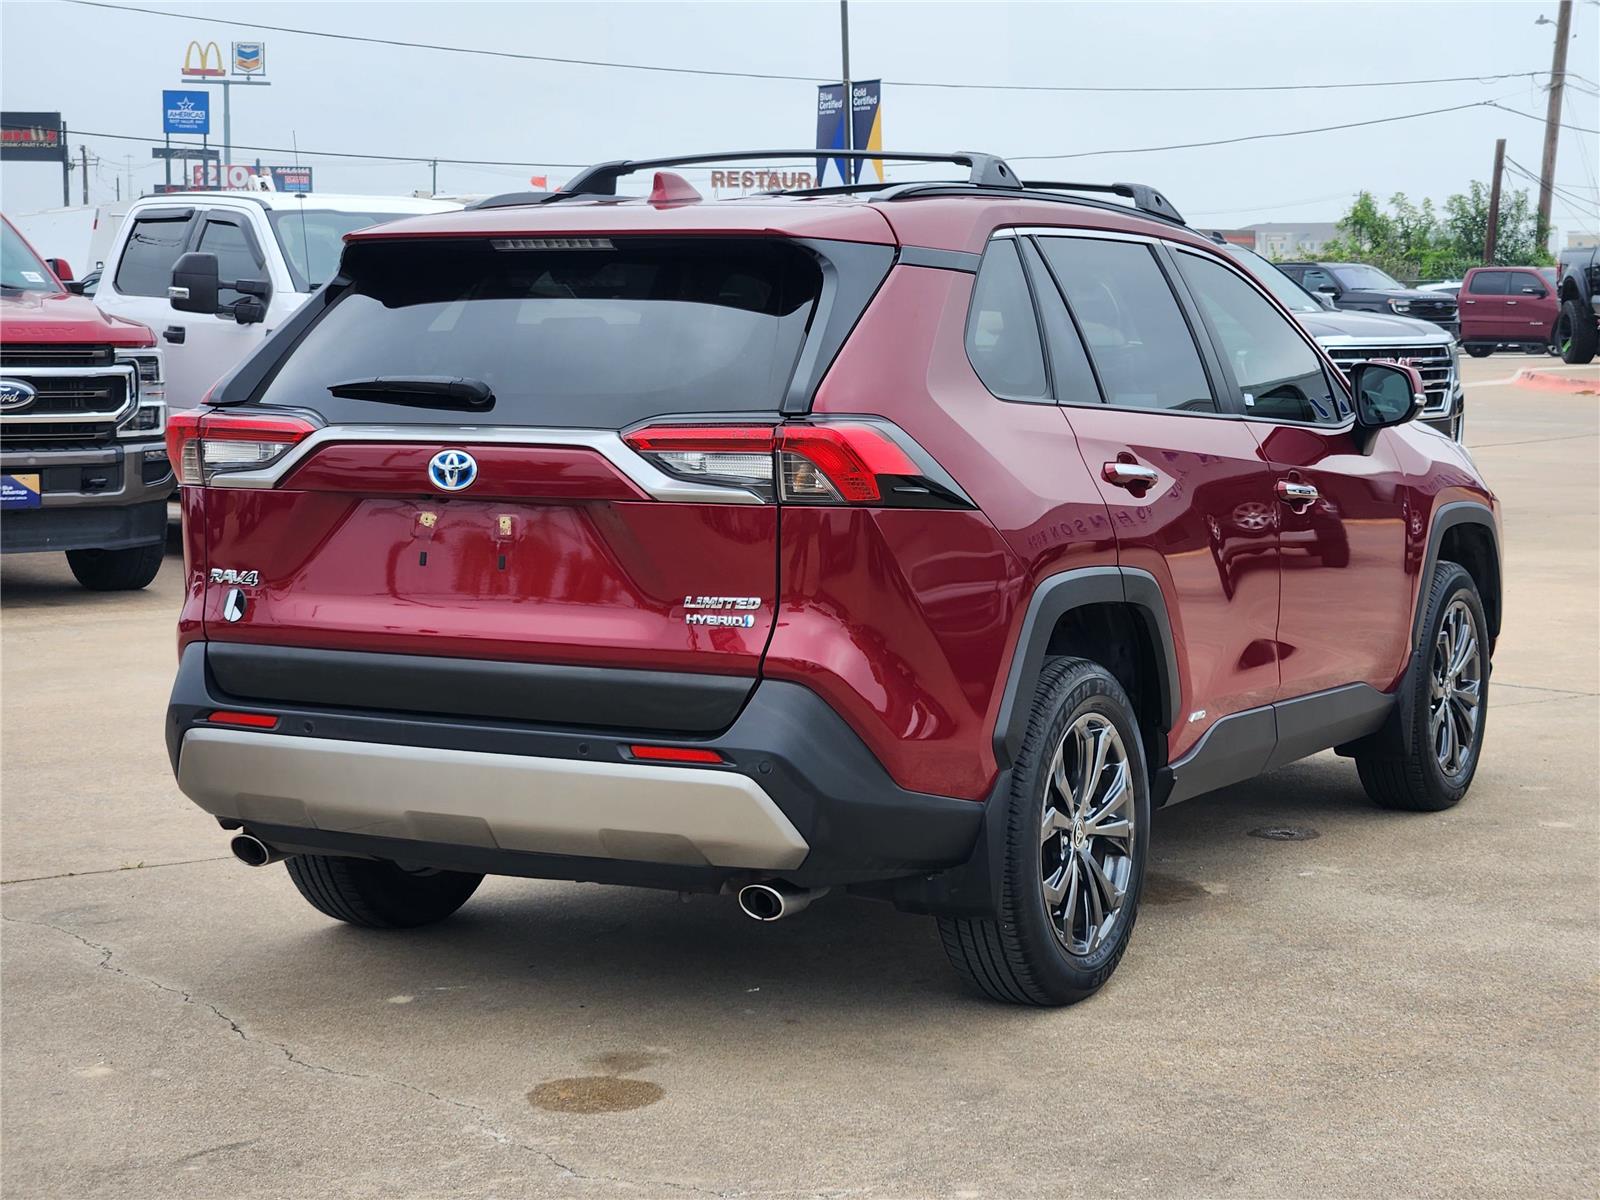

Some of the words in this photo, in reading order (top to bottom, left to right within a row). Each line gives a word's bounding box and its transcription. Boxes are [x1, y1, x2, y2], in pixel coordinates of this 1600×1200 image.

[819, 92, 833, 101] Blue
[853, 88, 867, 97] Gold
[819, 99, 843, 110] Certified
[853, 95, 878, 106] Certified
[209, 567, 259, 587] RAV4
[683, 595, 762, 610] LIMITED
[685, 613, 744, 627] HYBRID
